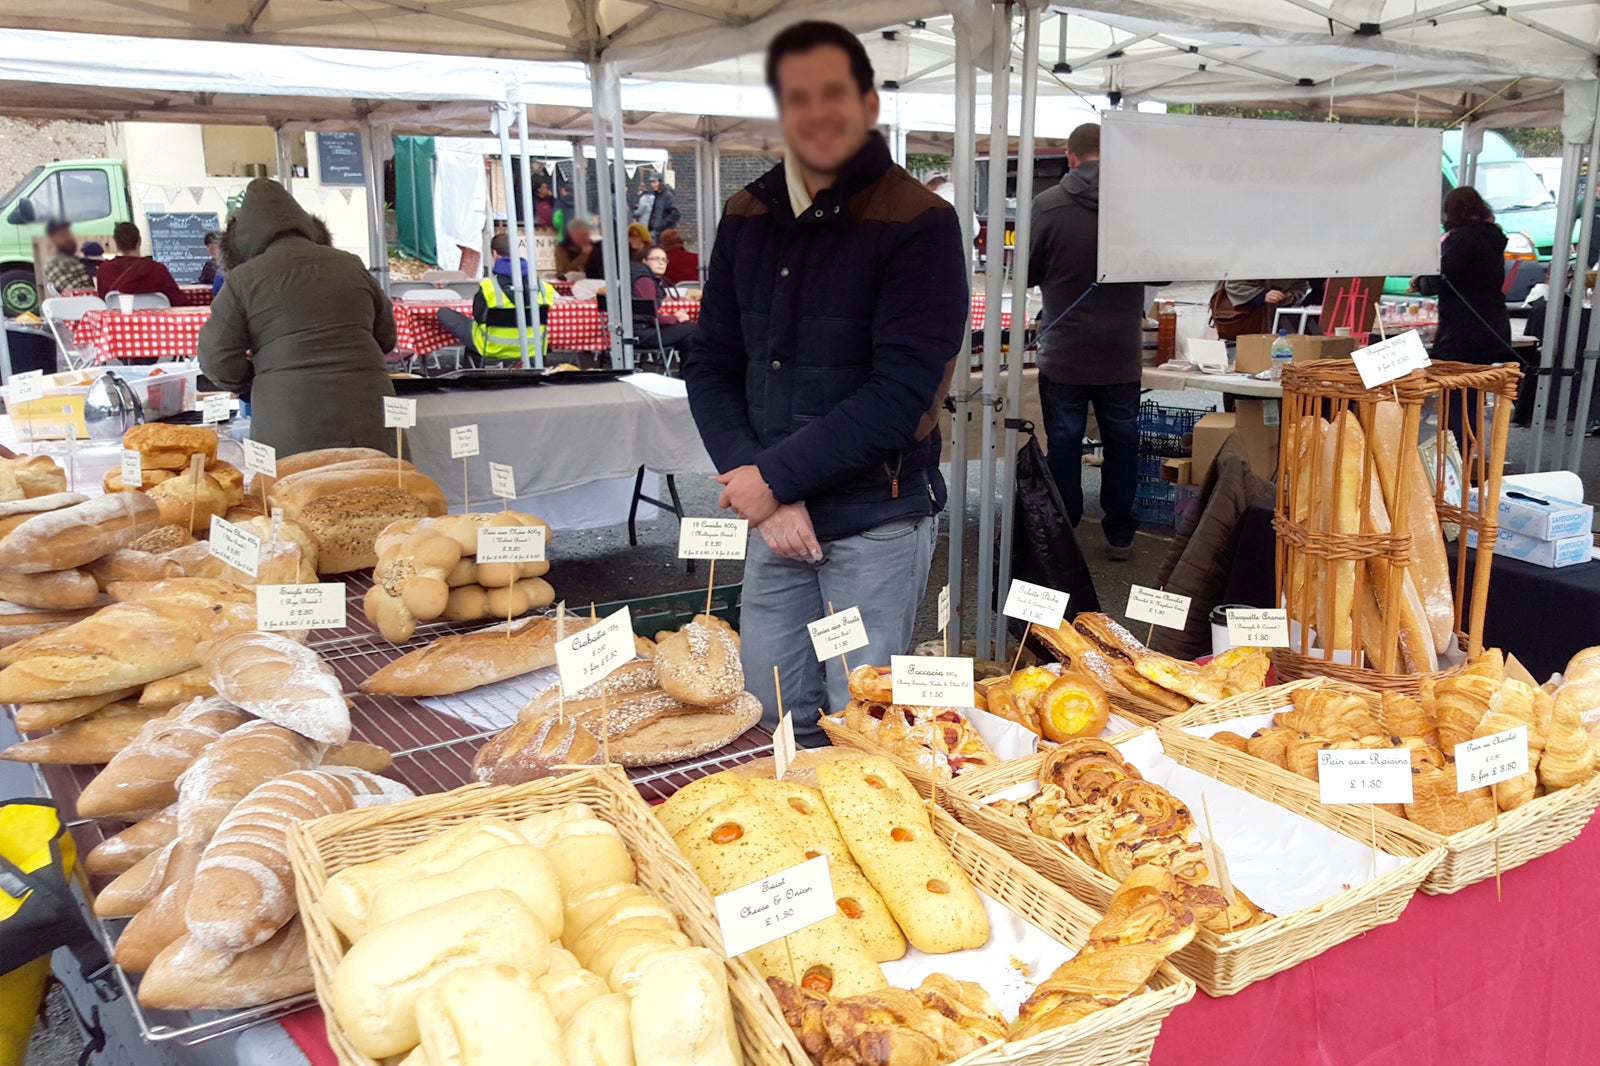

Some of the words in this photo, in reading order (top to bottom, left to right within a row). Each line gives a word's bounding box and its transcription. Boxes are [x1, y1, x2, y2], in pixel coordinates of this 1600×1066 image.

[1322, 753, 1344, 765] Pain
[1370, 753, 1408, 765] Raisins
[1478, 769, 1489, 783] for
[1492, 767, 1497, 775] £
[1350, 780, 1356, 788] £
[740, 905, 770, 918] Cheese
[773, 895, 782, 905] &
[786, 886, 812, 899] Onion
[765, 917, 772, 926] £
